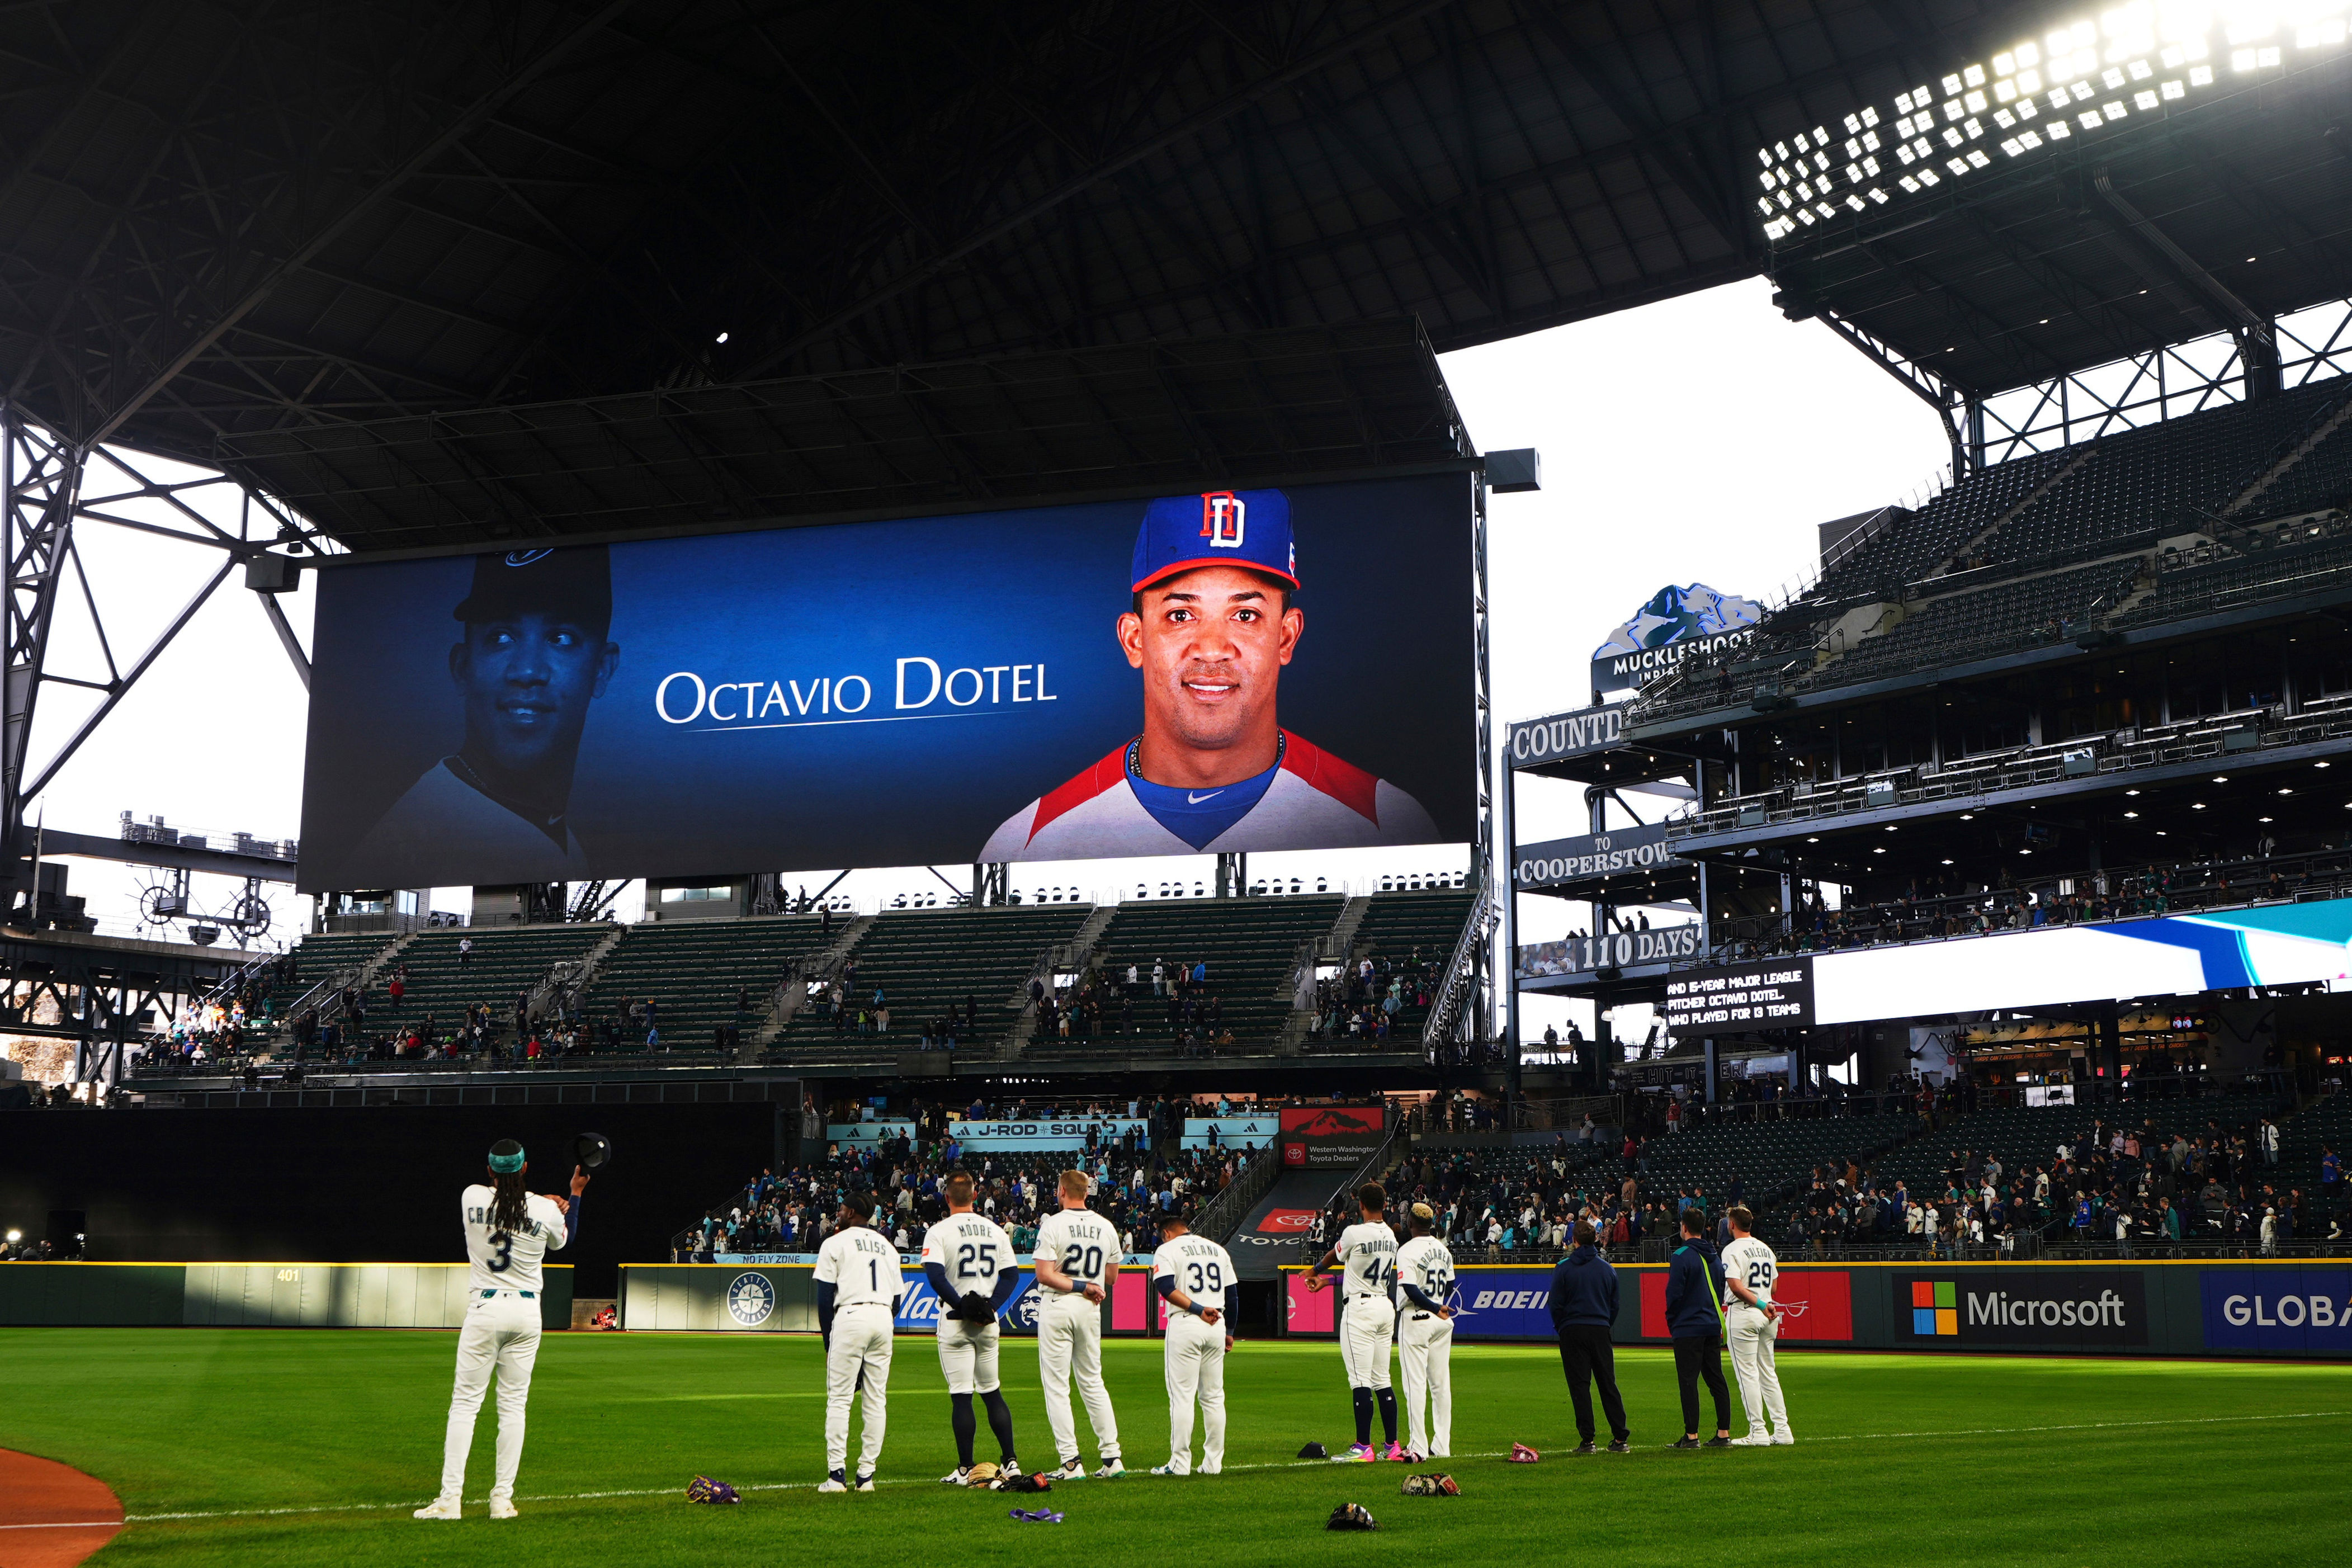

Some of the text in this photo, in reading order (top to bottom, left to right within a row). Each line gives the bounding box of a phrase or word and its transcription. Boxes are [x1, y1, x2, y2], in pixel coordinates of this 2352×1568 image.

[655, 657, 1057, 724] OCTAVIO DOTEL
[1513, 709, 1622, 759] COUNTD
[1595, 836, 1611, 852] TO
[1519, 841, 1671, 883] COOPERSTOW
[1583, 928, 1695, 969] 110 DAYS
[1668, 970, 1802, 995] AND 15-YEAR MAJOR LEAGUE
[1668, 996, 1706, 1010] PITCHER
[1709, 992, 1748, 1006] OCTAVIO
[1669, 1003, 1801, 1026] WHO PLAYED FOR 13 TEAMS
[979, 1124, 1037, 1136] J-ROD
[1309, 1155, 1332, 1163] Toyota
[958, 1224, 993, 1238] MOORE
[1069, 1225, 1102, 1240] RALEY
[1238, 1234, 1304, 1246] TOYO
[487, 1231, 513, 1273] 3
[854, 1239, 886, 1256] BLISS
[1181, 1245, 1218, 1257] SOLANO
[743, 1255, 800, 1264] NO FLY ZONE
[958, 1243, 997, 1278] 25
[1061, 1243, 1103, 1279] 20
[1417, 1249, 1452, 1272] AROZAREN
[277, 1269, 299, 1282] 401
[868, 1258, 877, 1293] 1
[1187, 1262, 1222, 1293] 39
[1363, 1257, 1393, 1286] 44
[1425, 1268, 1447, 1297] 56
[1749, 1261, 1772, 1288] 29
[732, 1276, 771, 1294] SEATTLE
[1472, 1291, 1549, 1310] BOEI
[1967, 1289, 2126, 1327] Microsoft
[731, 1303, 771, 1322] MARINERS
